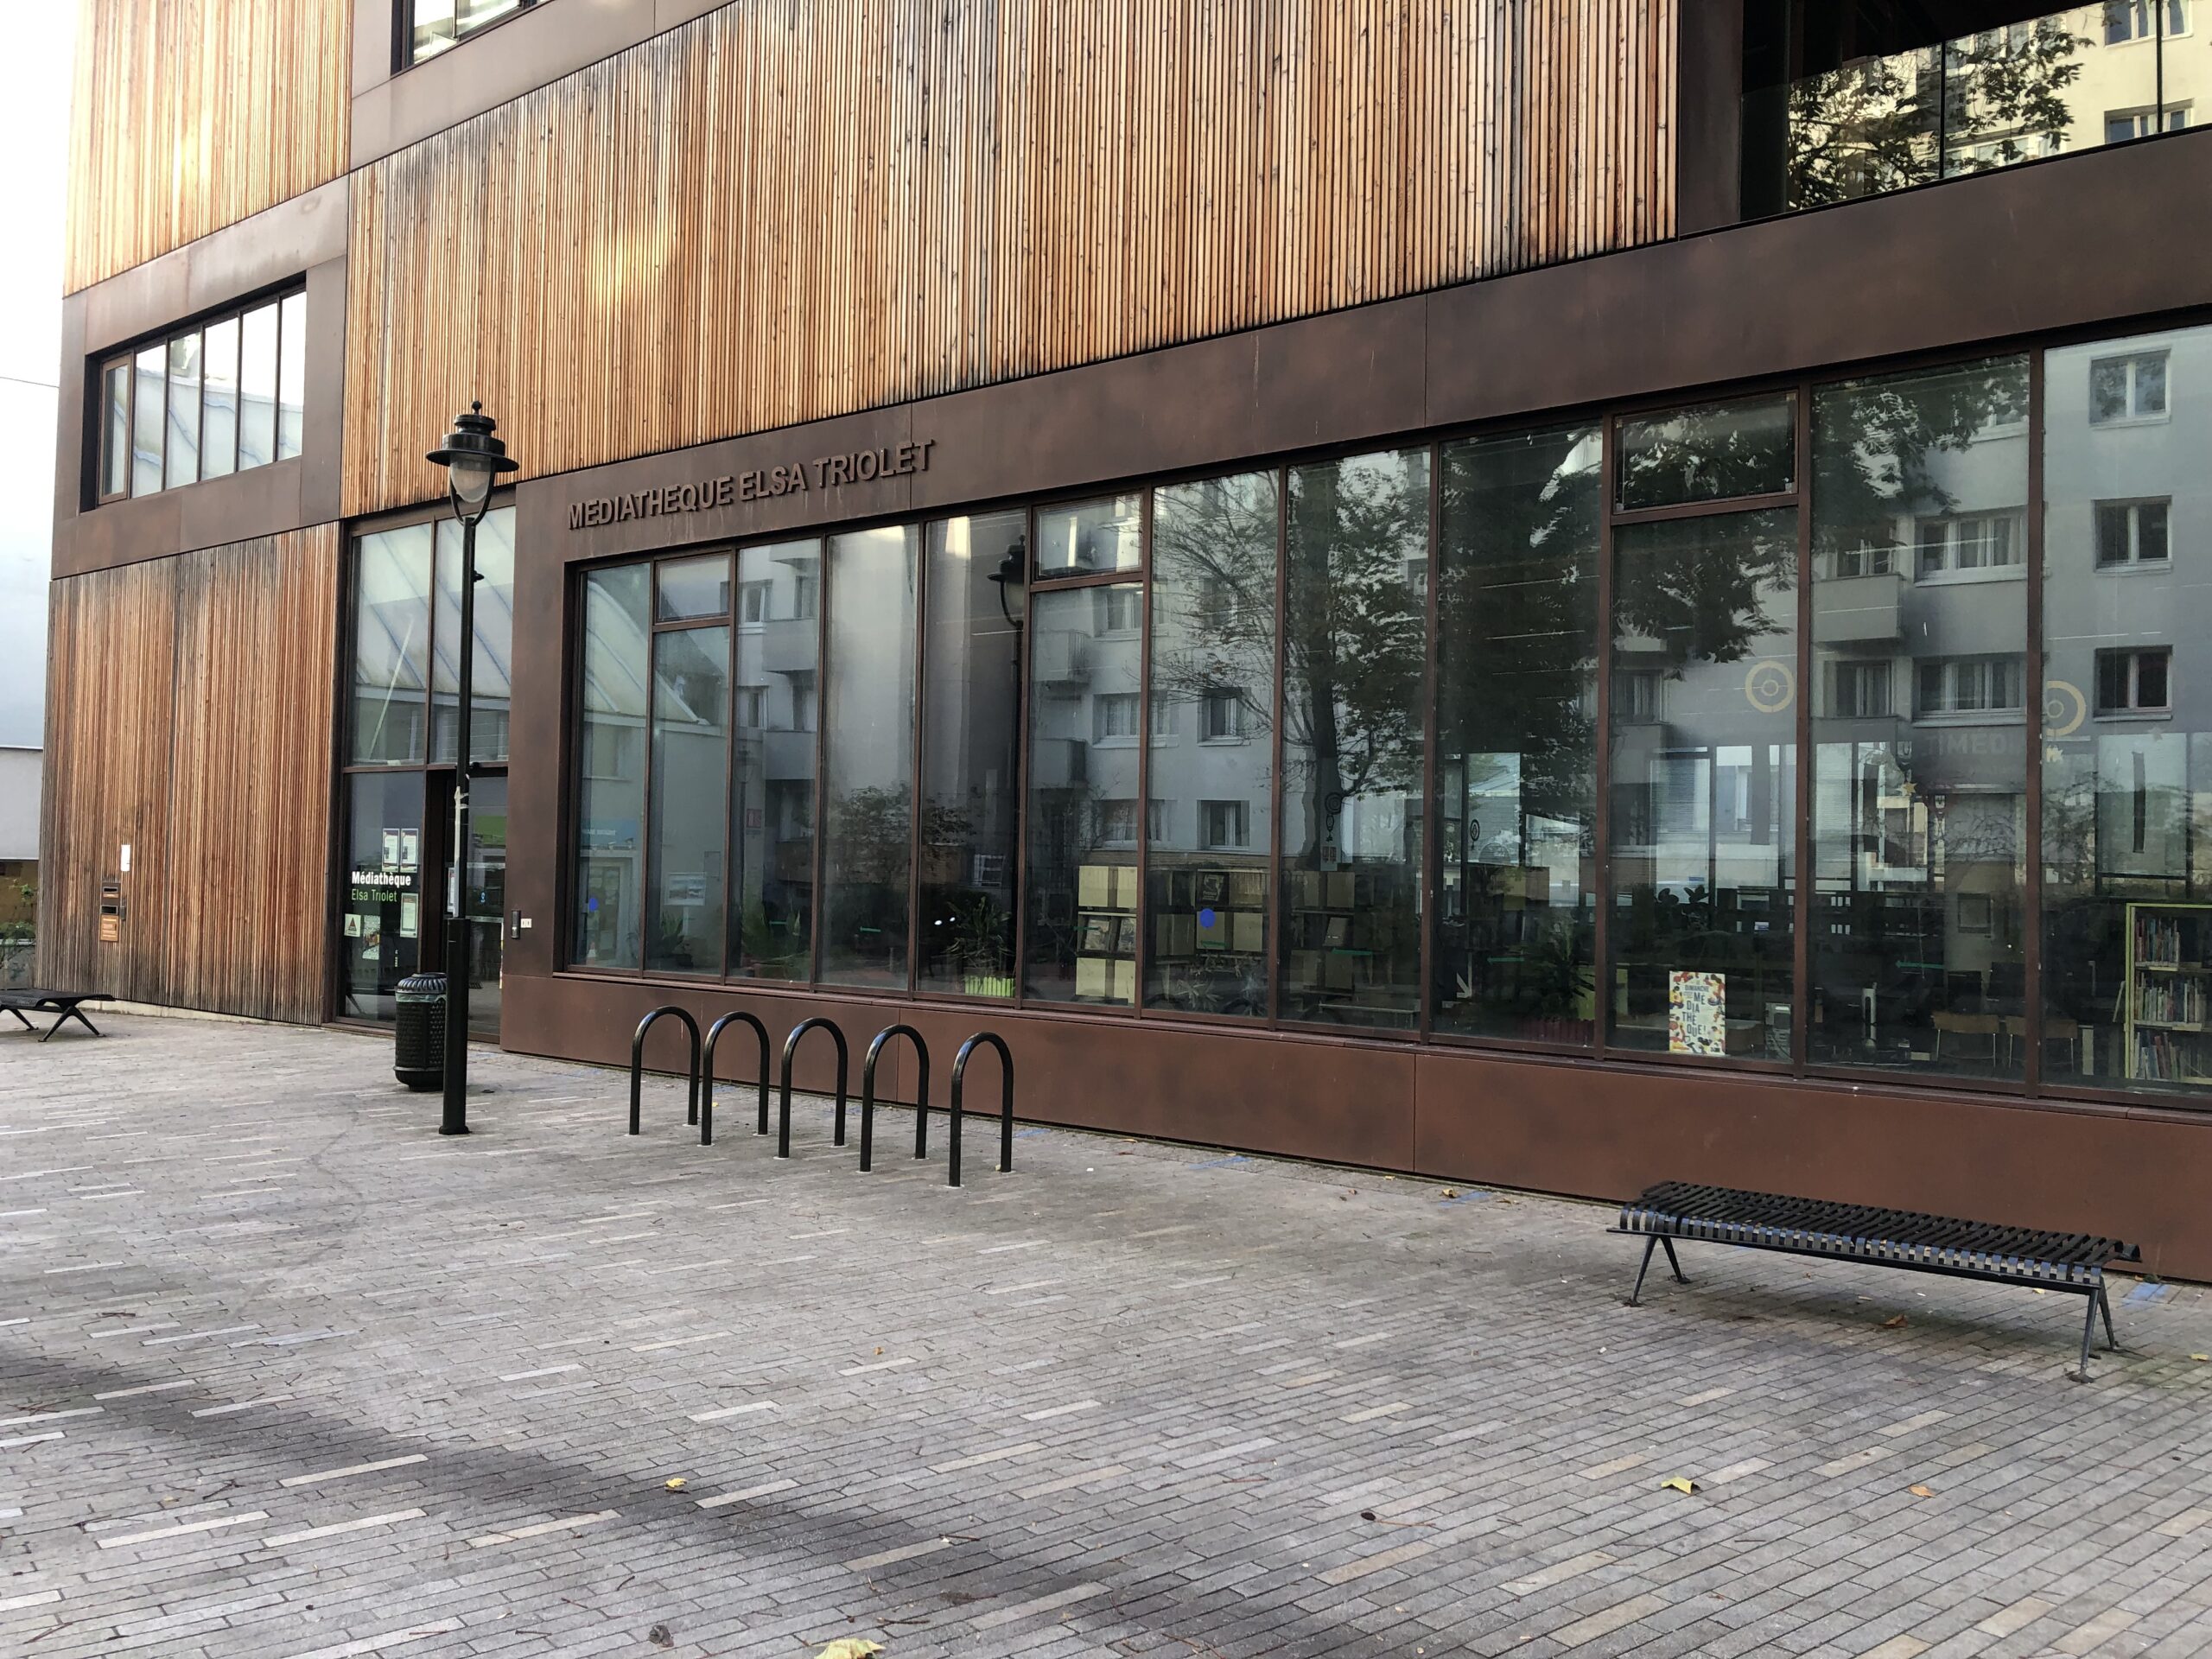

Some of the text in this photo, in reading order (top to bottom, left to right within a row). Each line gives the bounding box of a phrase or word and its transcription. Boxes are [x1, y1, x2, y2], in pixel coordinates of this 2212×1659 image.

[568, 439, 936, 531] MEDIATHEQUE ELSA TRIOLET
[352, 871, 411, 888] Médiathèque
[352, 888, 397, 903] Elsa Triolet
